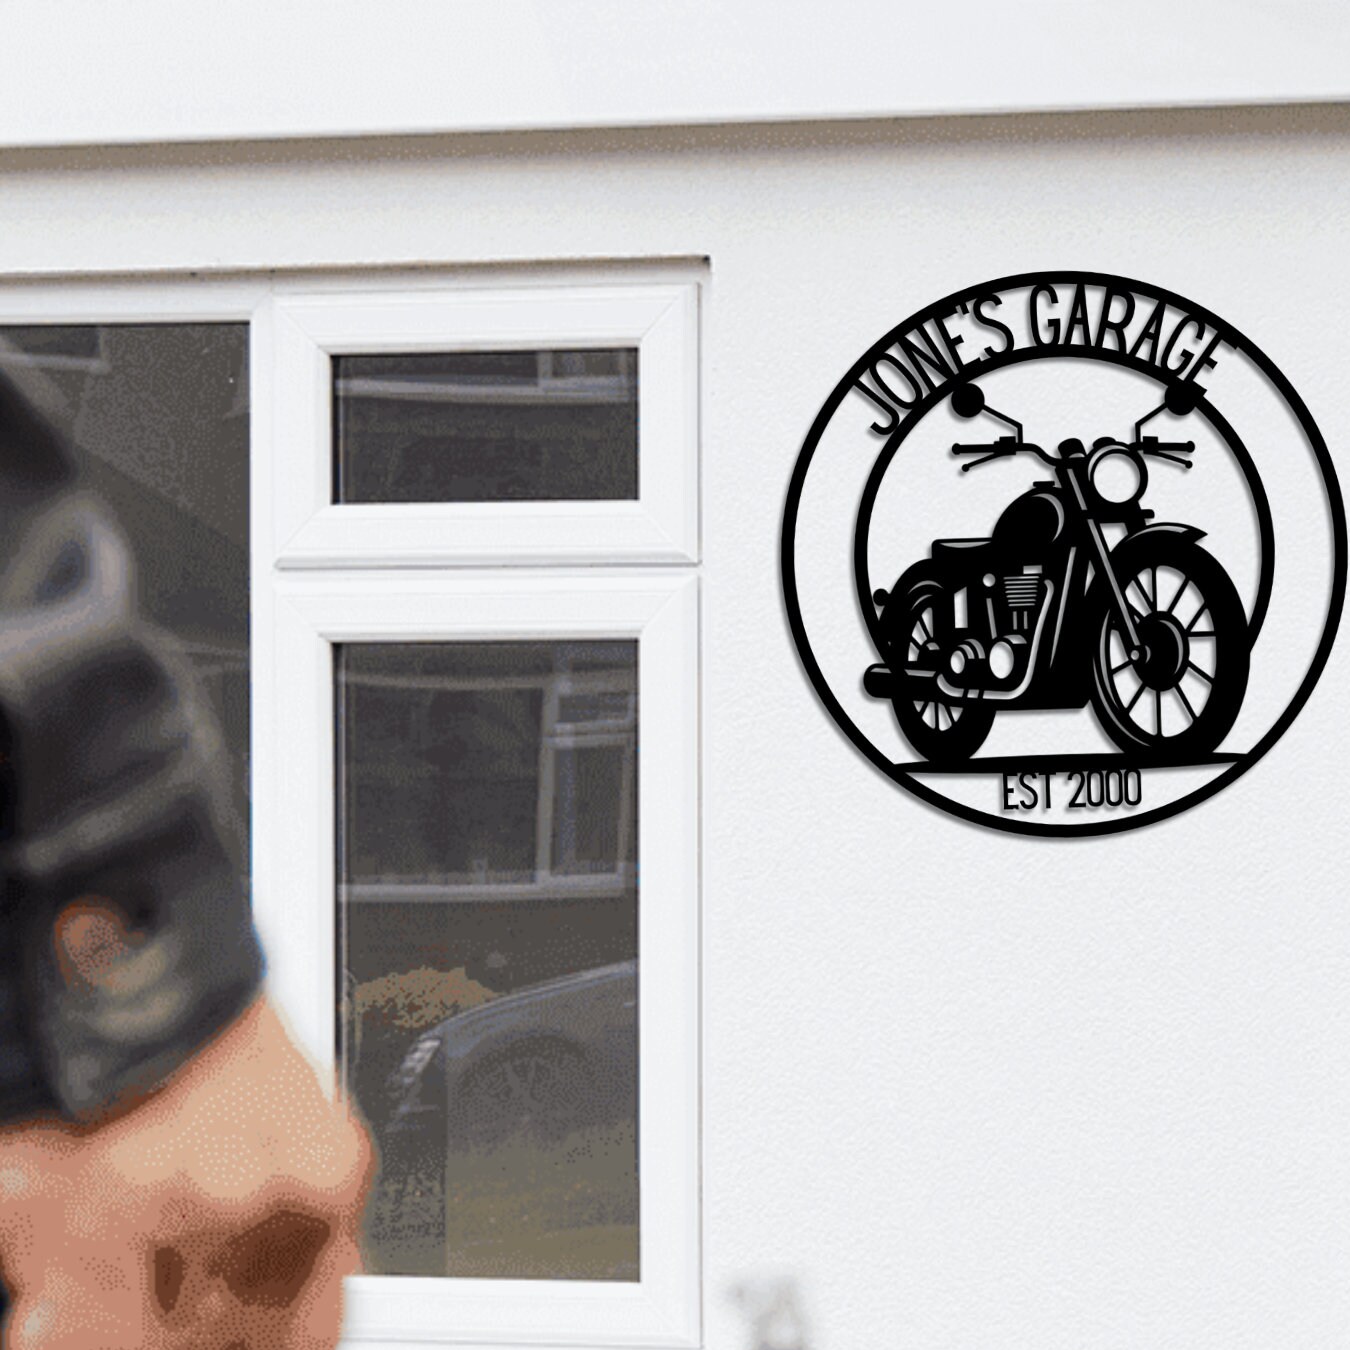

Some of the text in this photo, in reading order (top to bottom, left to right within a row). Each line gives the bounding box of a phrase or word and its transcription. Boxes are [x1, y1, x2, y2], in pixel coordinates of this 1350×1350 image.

[851, 283, 1238, 436] JONE'S GARAGE
[1002, 768, 1142, 810] EST 2000
